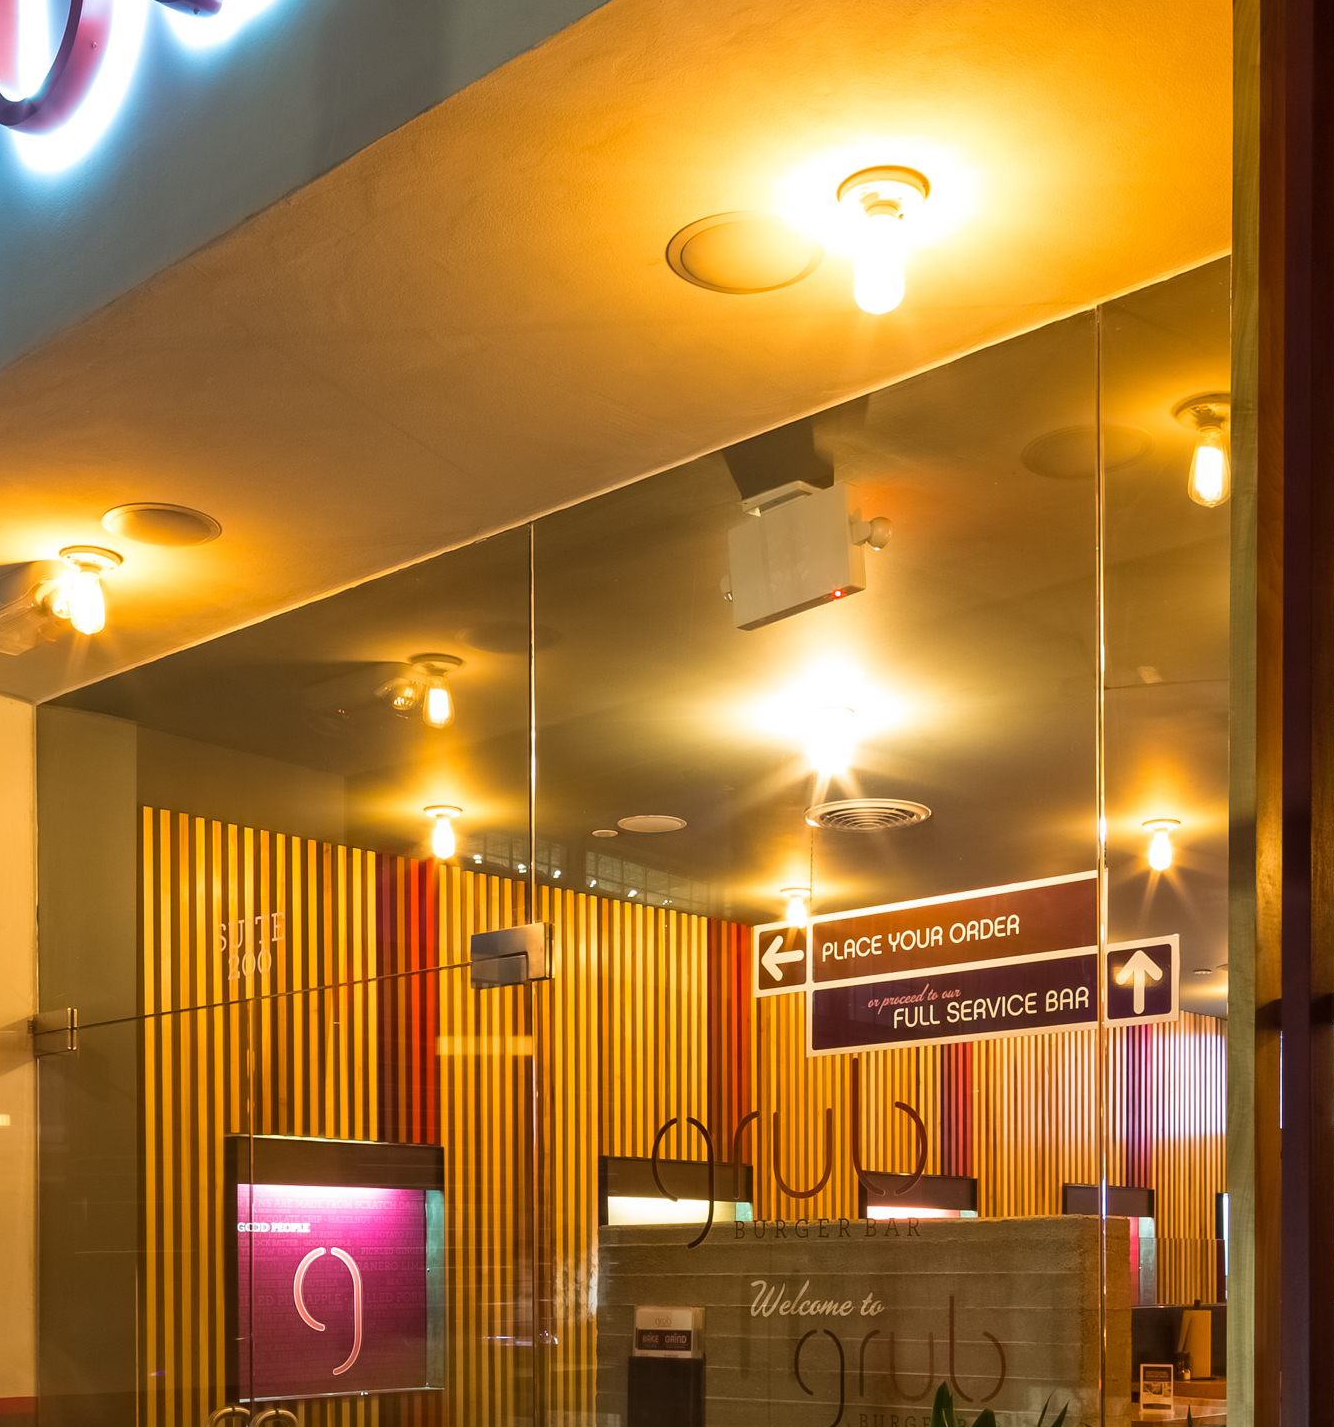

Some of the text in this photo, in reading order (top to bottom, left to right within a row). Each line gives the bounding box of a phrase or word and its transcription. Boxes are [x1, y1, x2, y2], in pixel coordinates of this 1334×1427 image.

[216, 912, 284, 952] SUITE
[822, 914, 1020, 962] PLACE YOUR ORDER
[228, 948, 272, 981] 200
[868, 983, 962, 1015] or proceed to our
[893, 986, 1090, 1029] FULL SERVICE BAR
[652, 1057, 928, 1249] grub
[247, 1214, 300, 1223] HOCOLATE
[301, 1215, 322, 1223] CHIP
[328, 1216, 371, 1224] HAZELNUT
[274, 1199, 294, 1208] ARE
[295, 1199, 323, 1209] MADE
[325, 1199, 352, 1209] FROM
[354, 1200, 397, 1210] SCRATCH
[237, 1222, 270, 1232] GOOD
[271, 1222, 311, 1233] PEOPLE
[734, 1217, 921, 1239] BURGER BAR
[360, 1247, 394, 1255] PICKLED
[750, 1279, 885, 1317] Welcome to
